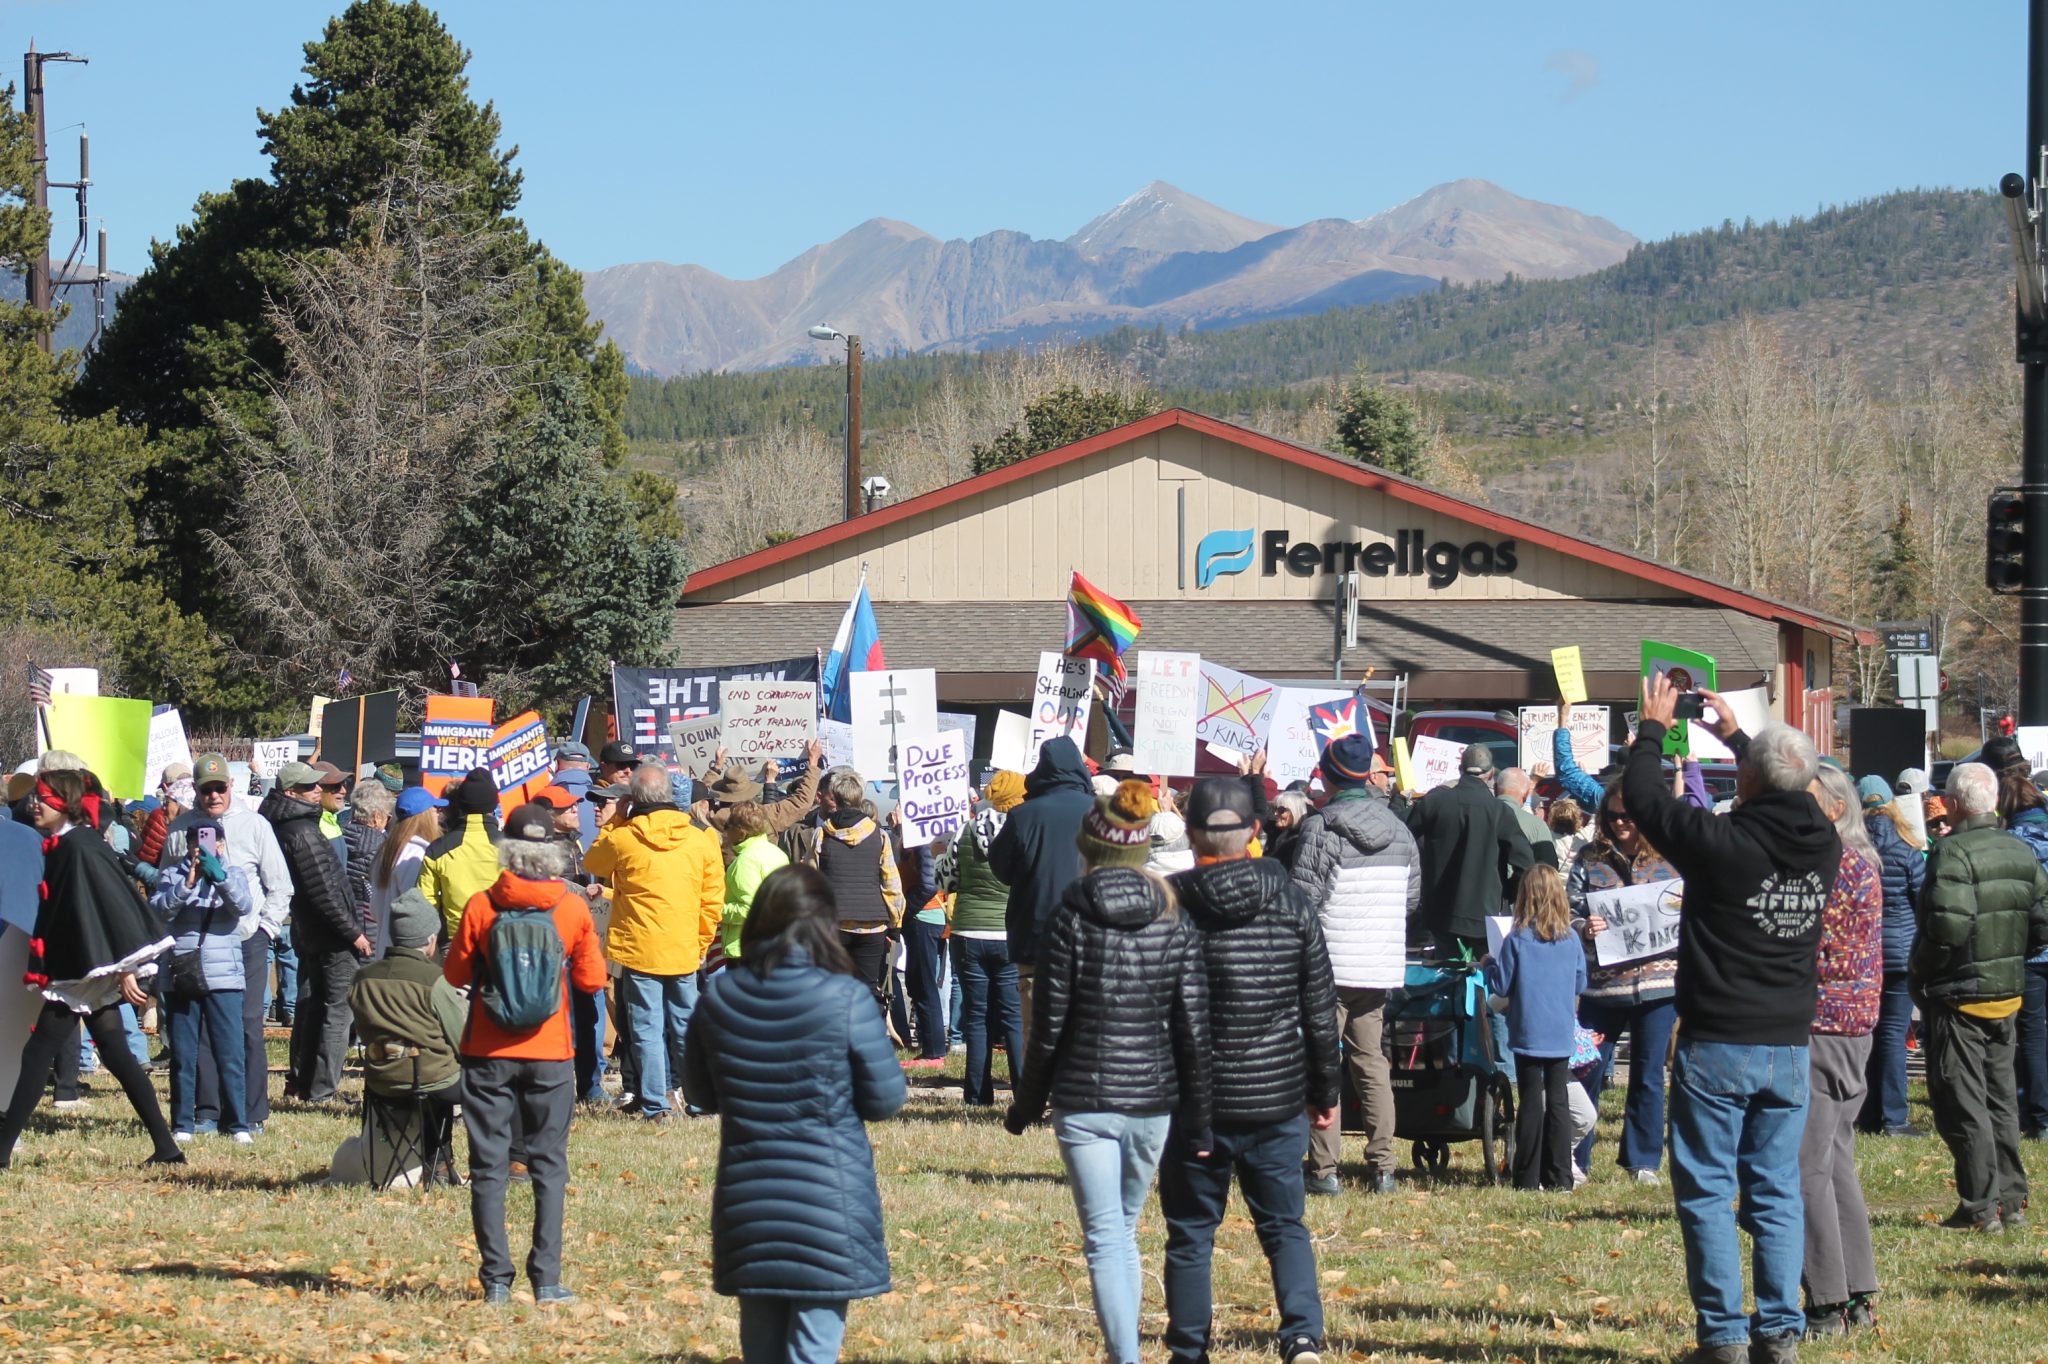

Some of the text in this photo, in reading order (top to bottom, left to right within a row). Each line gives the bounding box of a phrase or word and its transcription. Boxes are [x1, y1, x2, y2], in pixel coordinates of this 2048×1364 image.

[1262, 530, 1517, 589] Ferrellgas
[1056, 659, 1086, 675] HE'S
[1151, 656, 1192, 677] LET
[727, 690, 812, 701] END CORRUPTION
[753, 705, 777, 715] BAN
[1040, 701, 1084, 731] OUR
[1526, 712, 1556, 723] TRUMP
[1571, 712, 1604, 722] ENEMY
[729, 717, 808, 731] STOCK TRADING
[1152, 718, 1178, 729] NOT
[1568, 722, 1599, 732] WITHIN
[424, 726, 495, 738] IMMIGRANTS
[680, 726, 720, 748] JOUNA
[759, 730, 772, 740] BY
[1196, 719, 1263, 753] O KINGS
[1286, 726, 1312, 741] SILE
[488, 723, 545, 760] IMMIGRANTS
[741, 739, 806, 752] CONGRESS
[421, 745, 490, 770] HERE
[692, 746, 707, 759] IS
[907, 744, 953, 767] DUE
[266, 768, 281, 776] OU
[491, 742, 549, 790] HERE
[1280, 762, 1313, 778] DEMO
[1761, 871, 1823, 893] BY ERS
[1746, 893, 1827, 911] 4FRNT
[1752, 912, 1816, 938] FOR SKIERS
[1623, 924, 1680, 955] KING
[1391, 1080, 1413, 1088] HULE
